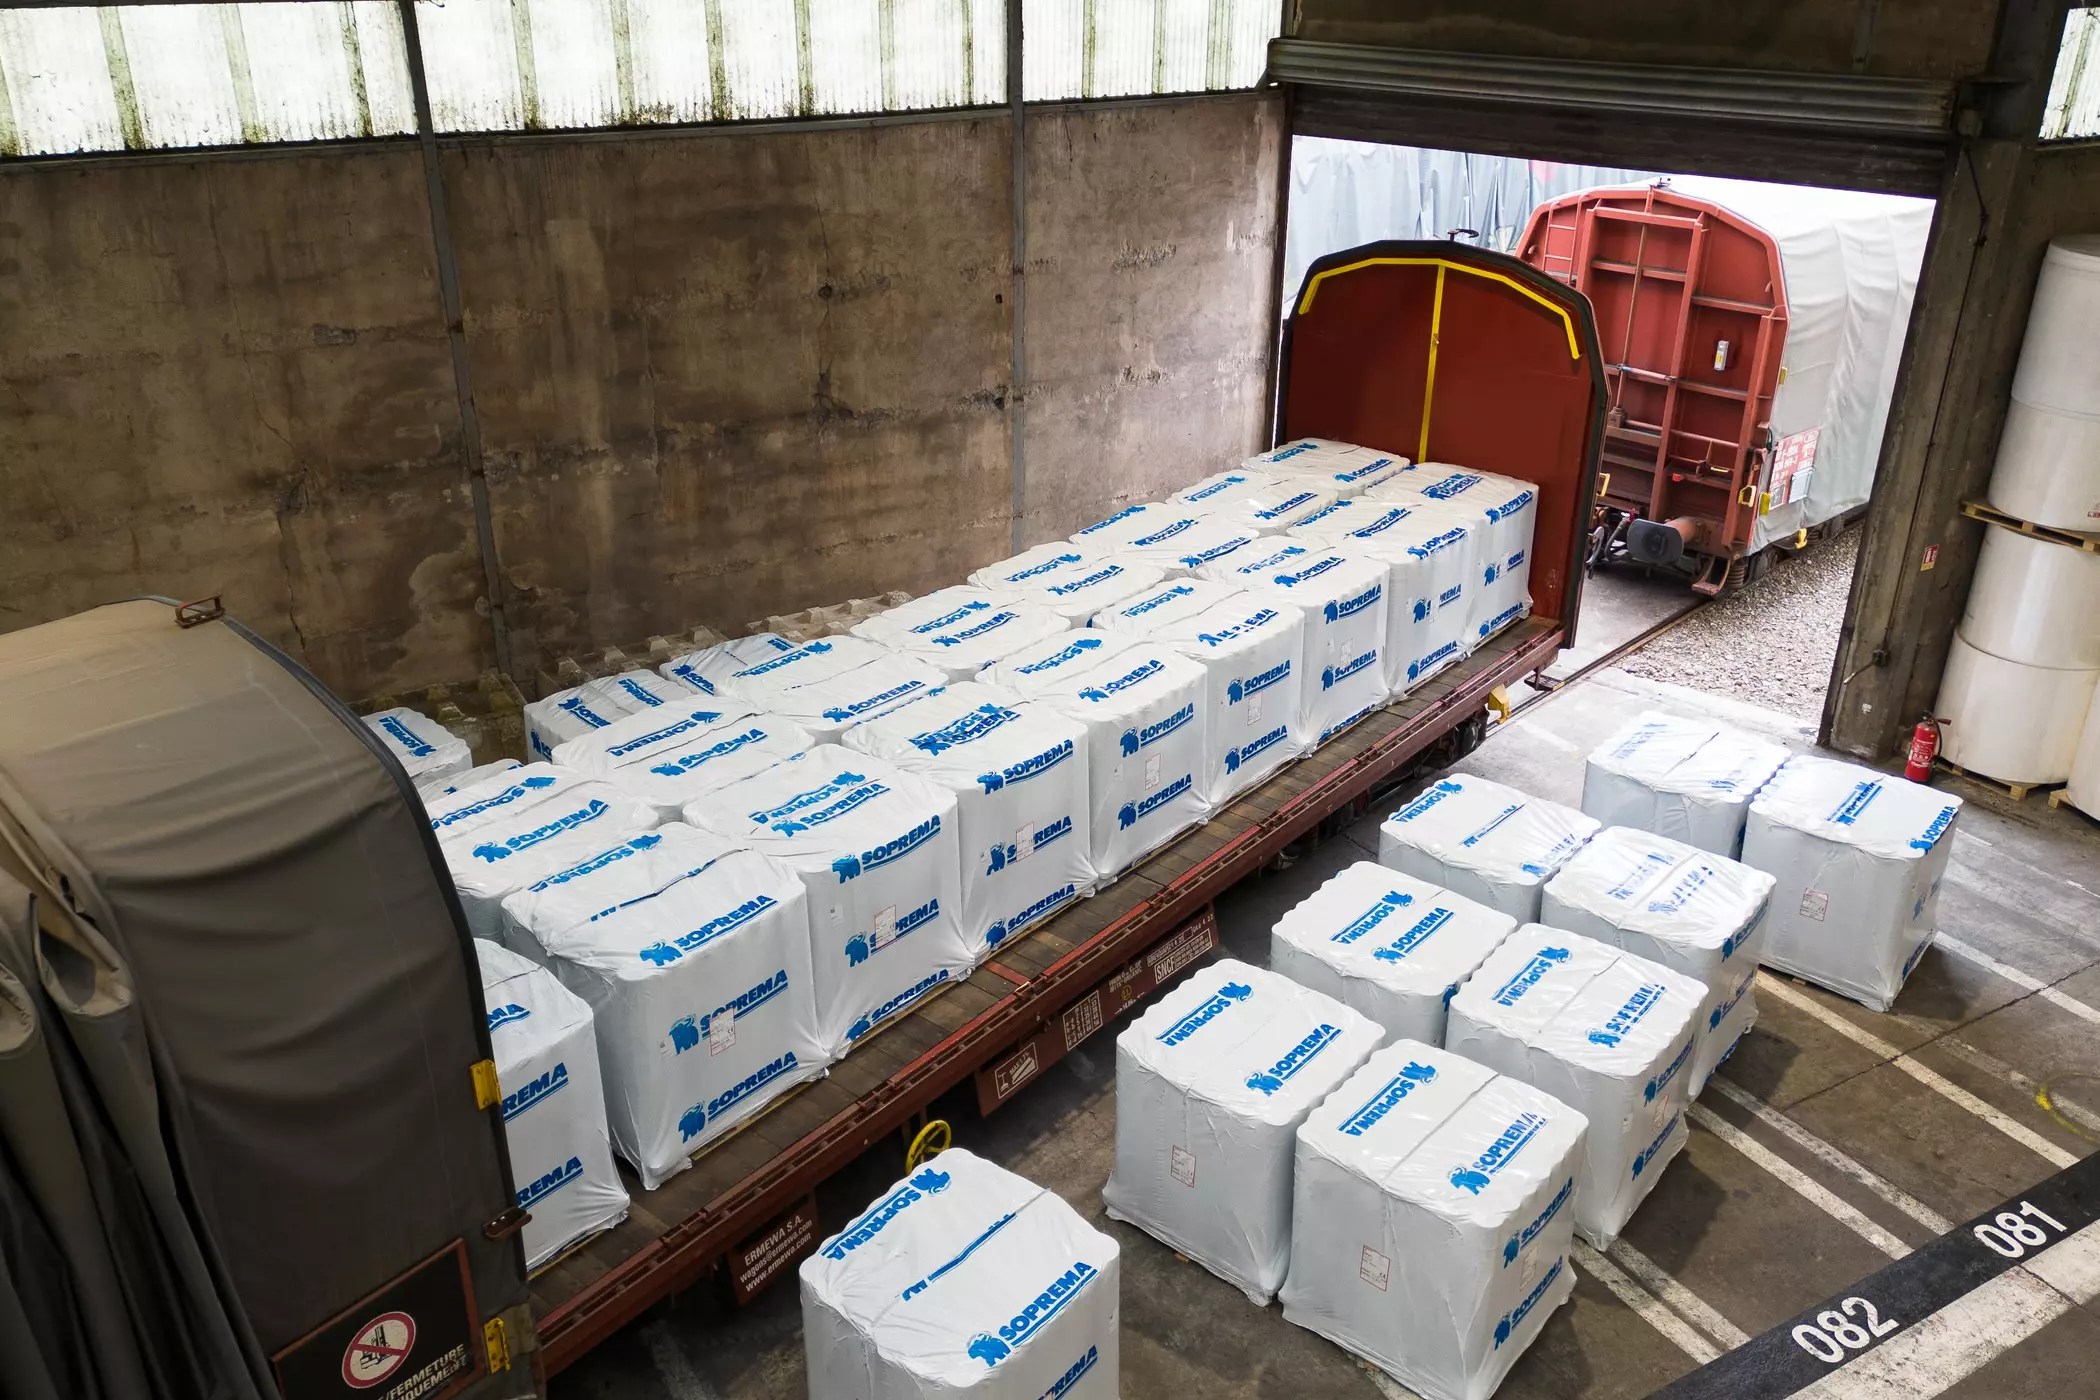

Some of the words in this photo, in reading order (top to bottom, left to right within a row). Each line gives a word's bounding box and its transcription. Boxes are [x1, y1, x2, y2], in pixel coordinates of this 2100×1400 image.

[1339, 584, 1381, 614] SOPREMA
[1490, 602, 1523, 628] SOPREMA
[1243, 660, 1290, 693] SOPREMA
[1420, 641, 1457, 668] SOPREMA
[847, 681, 922, 713] SOPREMA
[609, 721, 698, 757] SOPREMA
[1141, 703, 1194, 742] SOPREMA
[1241, 725, 1287, 759] SOPREMA
[678, 728, 765, 767] SOPREMA
[1002, 739, 1074, 780] SOPREMA
[752, 785, 840, 824] SOPREMA
[800, 783, 886, 825] SOPREMA
[1138, 773, 1192, 812] SOPREMA
[1395, 791, 1447, 823] SOPREMA
[506, 799, 606, 849] SOPREMA
[861, 814, 941, 865] SOPREMA
[1007, 815, 1072, 859] SREMA
[1922, 805, 1956, 841] SOPREMA
[674, 894, 774, 947] SOPREMA
[869, 898, 940, 949] SREMA
[1008, 883, 1075, 931] SOPREMA
[1338, 904, 1396, 945] SOPREMA
[1391, 906, 1449, 951] SOPREMA
[1156, 957, 1176, 980] SNCF
[1497, 960, 1554, 1008] SOPREMA
[871, 968, 949, 1020] SOPREMA
[1161, 998, 1232, 1047] SOPREMA
[1268, 1023, 1336, 1078] SOPREMA
[503, 1062, 568, 1116] REMA
[707, 1051, 797, 1115] SOPREMA
[1344, 1079, 1416, 1137] SOPREMA
[1472, 1111, 1541, 1171] SOPREMA
[515, 1156, 583, 1205] REMA
[744, 1228, 786, 1266] ERMEWA
[786, 1215, 804, 1232] S.A.
[827, 1188, 923, 1261] SOPREMA
[1972, 1200, 2068, 1259] 081
[739, 1219, 813, 1283] wagons@ermewa.com
[745, 1232, 811, 1292] www.ermewa.com
[999, 1261, 1093, 1341] SOPREMA
[1790, 1296, 1901, 1364] 082
